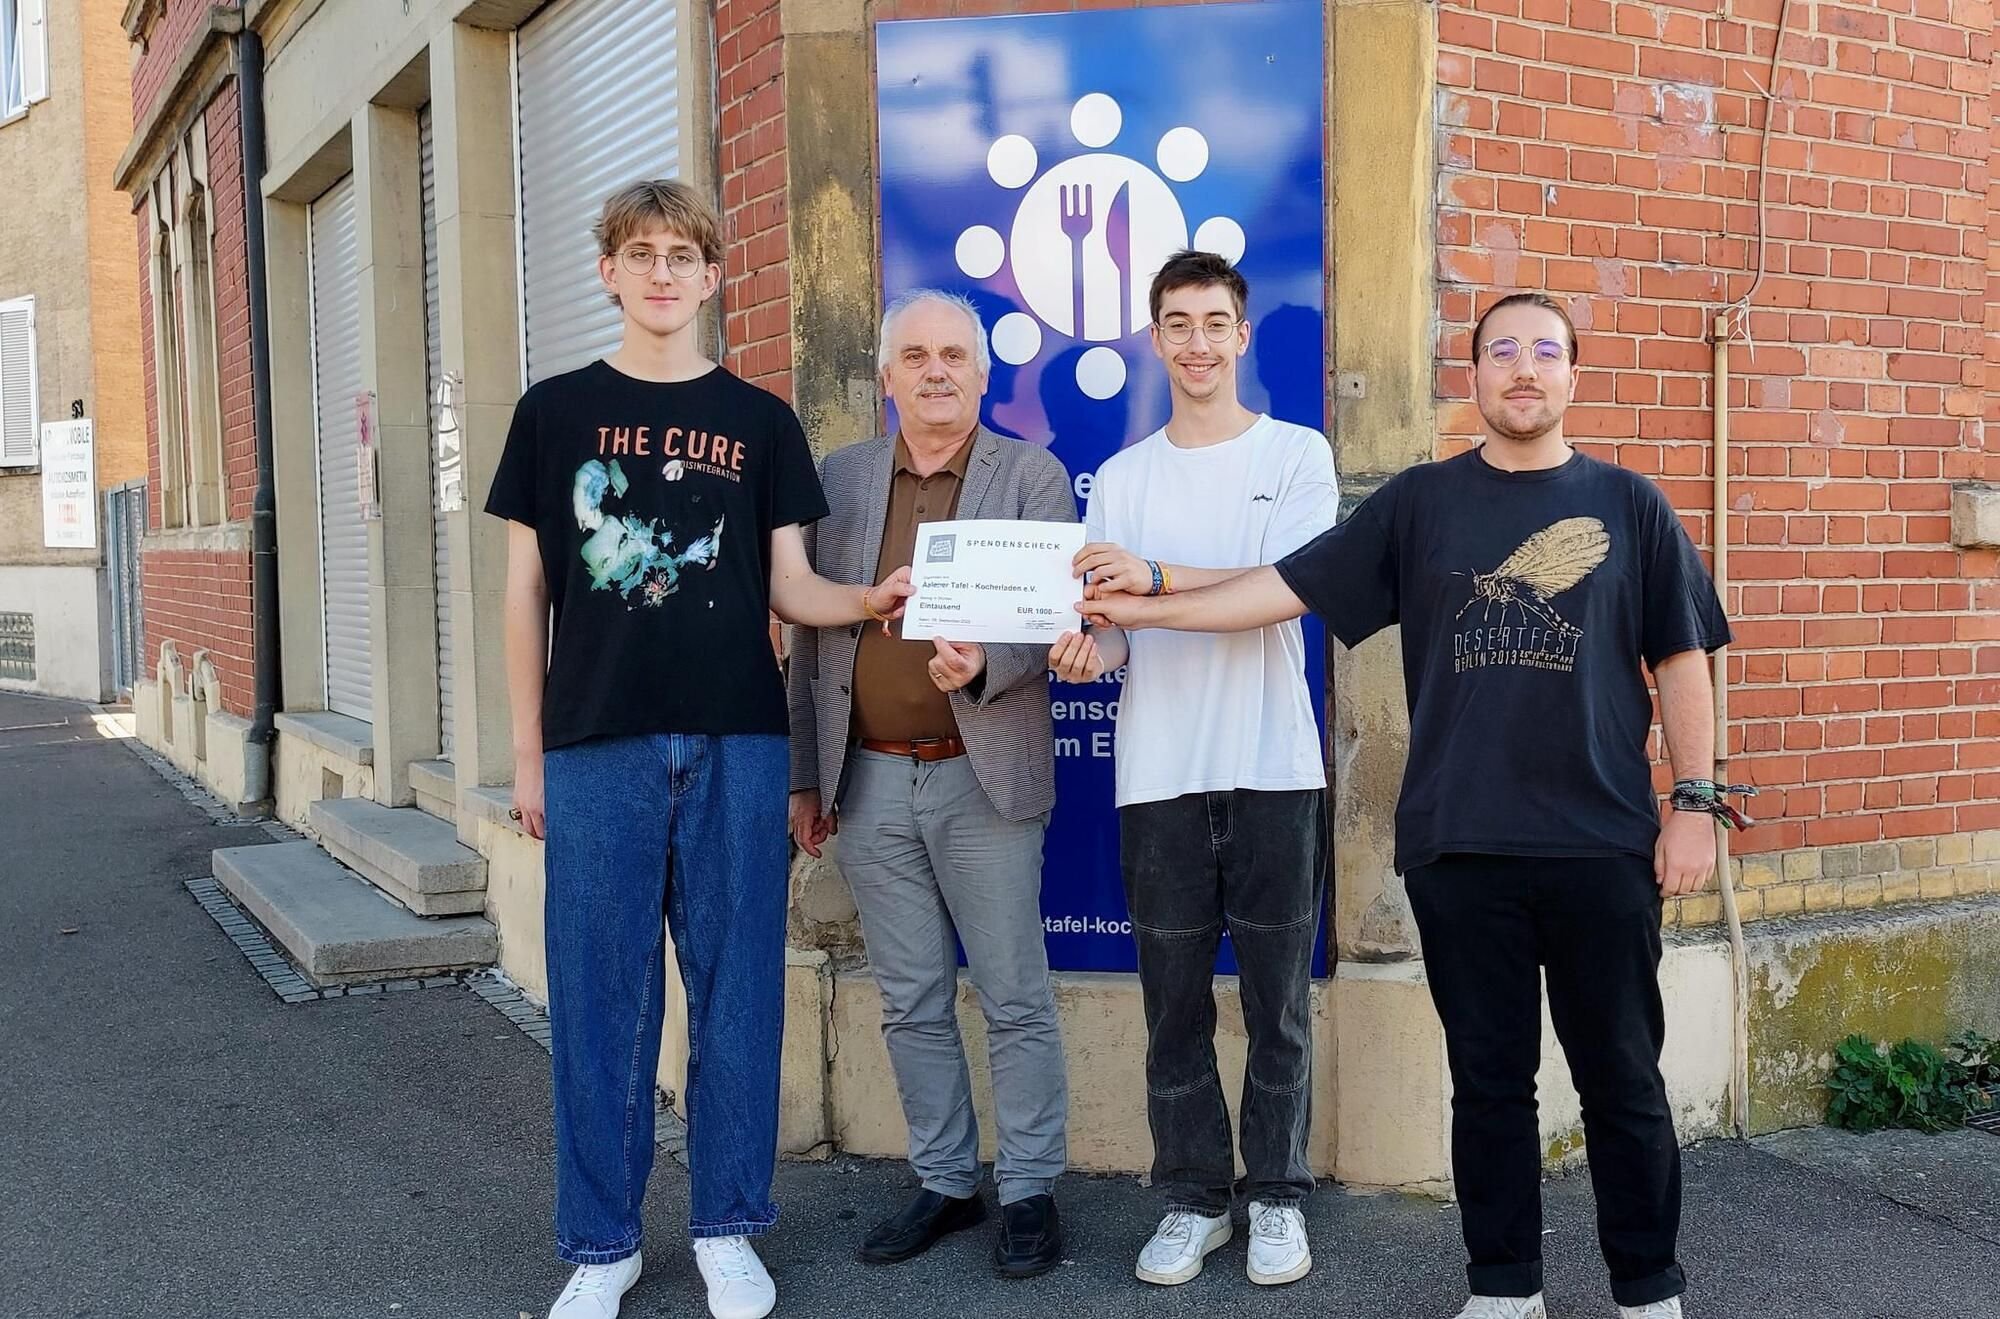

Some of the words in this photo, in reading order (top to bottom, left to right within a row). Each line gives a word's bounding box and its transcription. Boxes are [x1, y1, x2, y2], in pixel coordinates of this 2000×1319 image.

[597, 426, 651, 456] THE
[663, 427, 746, 471] CURE
[680, 460, 741, 484] DISINTEGRATION
[966, 539, 1062, 550] SPENDENSCHECK
[922, 581, 950, 589] Aalener
[951, 581, 969, 590] Tafel
[975, 583, 1022, 593] Kocherladen
[1023, 585, 1038, 593] e.V.
[919, 602, 961, 611] Eintausend
[1017, 606, 1034, 615] EUR
[1454, 626, 1583, 657] DESERTFEST
[1454, 651, 1487, 673] BERLIN
[1490, 649, 1518, 666] 2013
